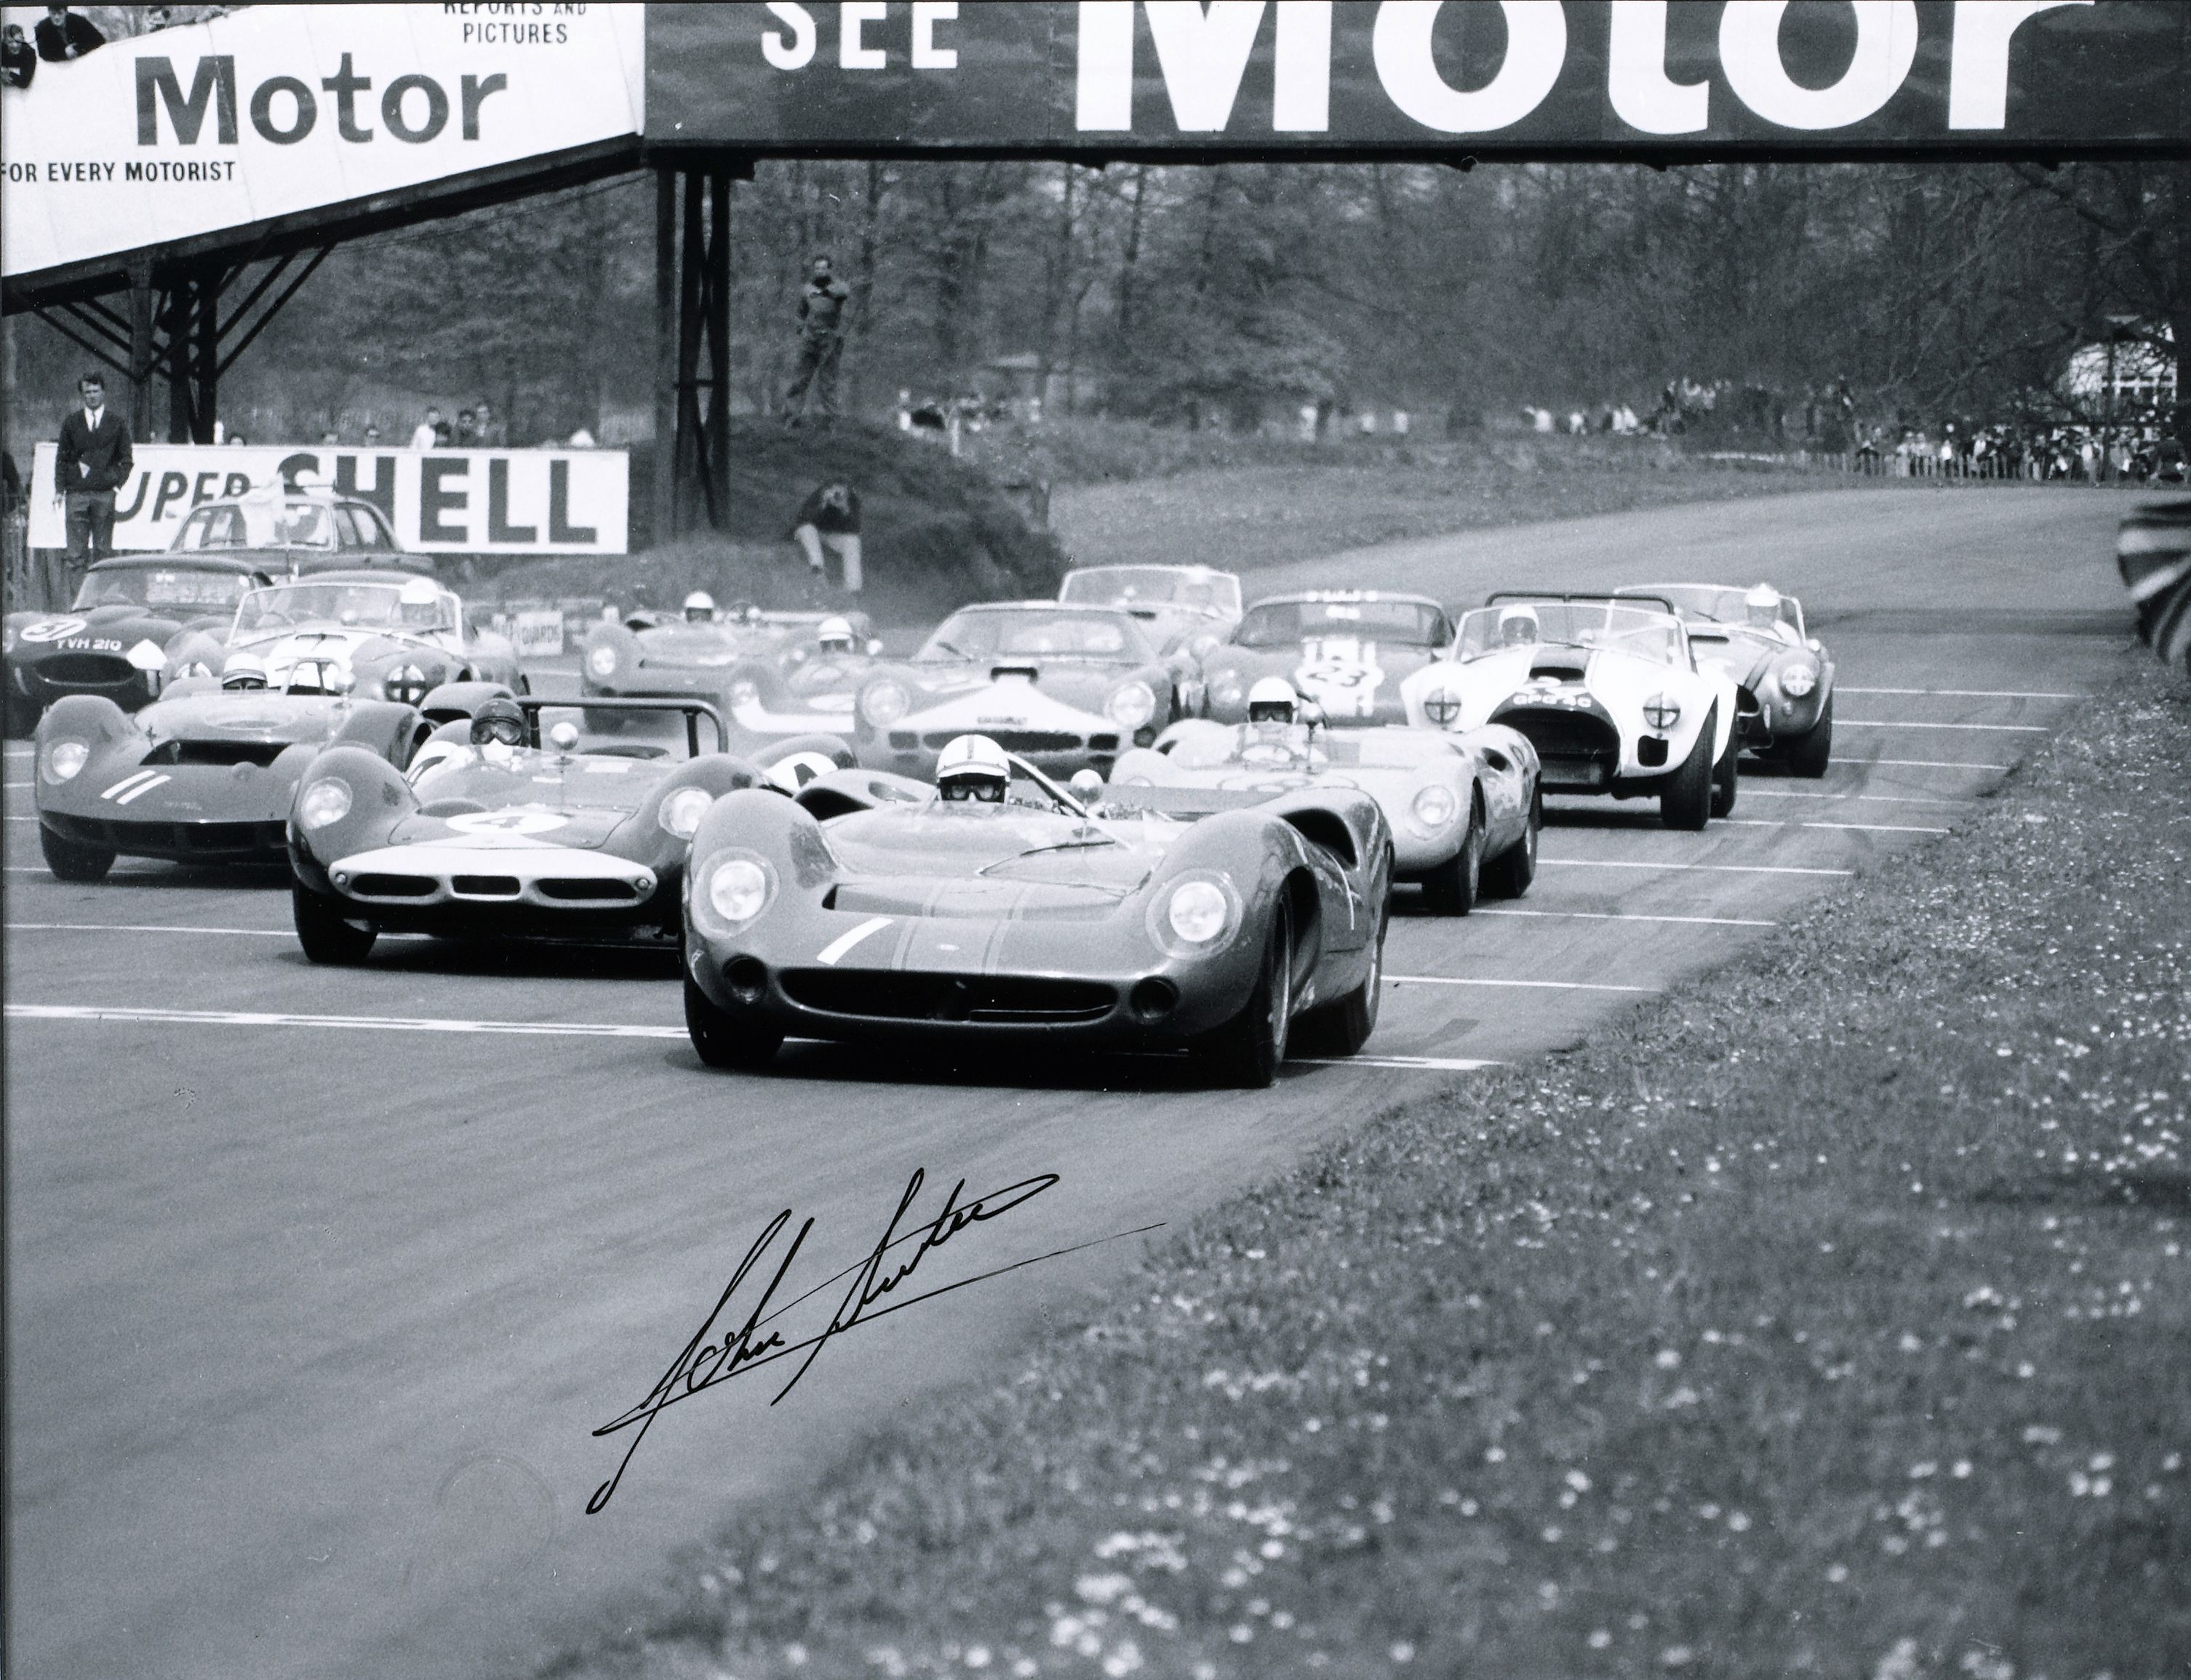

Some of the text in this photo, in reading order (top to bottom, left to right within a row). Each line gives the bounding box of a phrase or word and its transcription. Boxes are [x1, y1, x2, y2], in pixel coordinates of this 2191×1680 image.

[463, 23, 567, 44] PICTURES
[761, 1, 2096, 134] SEE Motor
[135, 52, 507, 145] Motor
[47, 161, 116, 182] EVERY
[125, 161, 236, 182] MOTORIST
[115, 471, 252, 523] UPER
[100, 769, 172, 805] 11
[471, 815, 527, 828] 4
